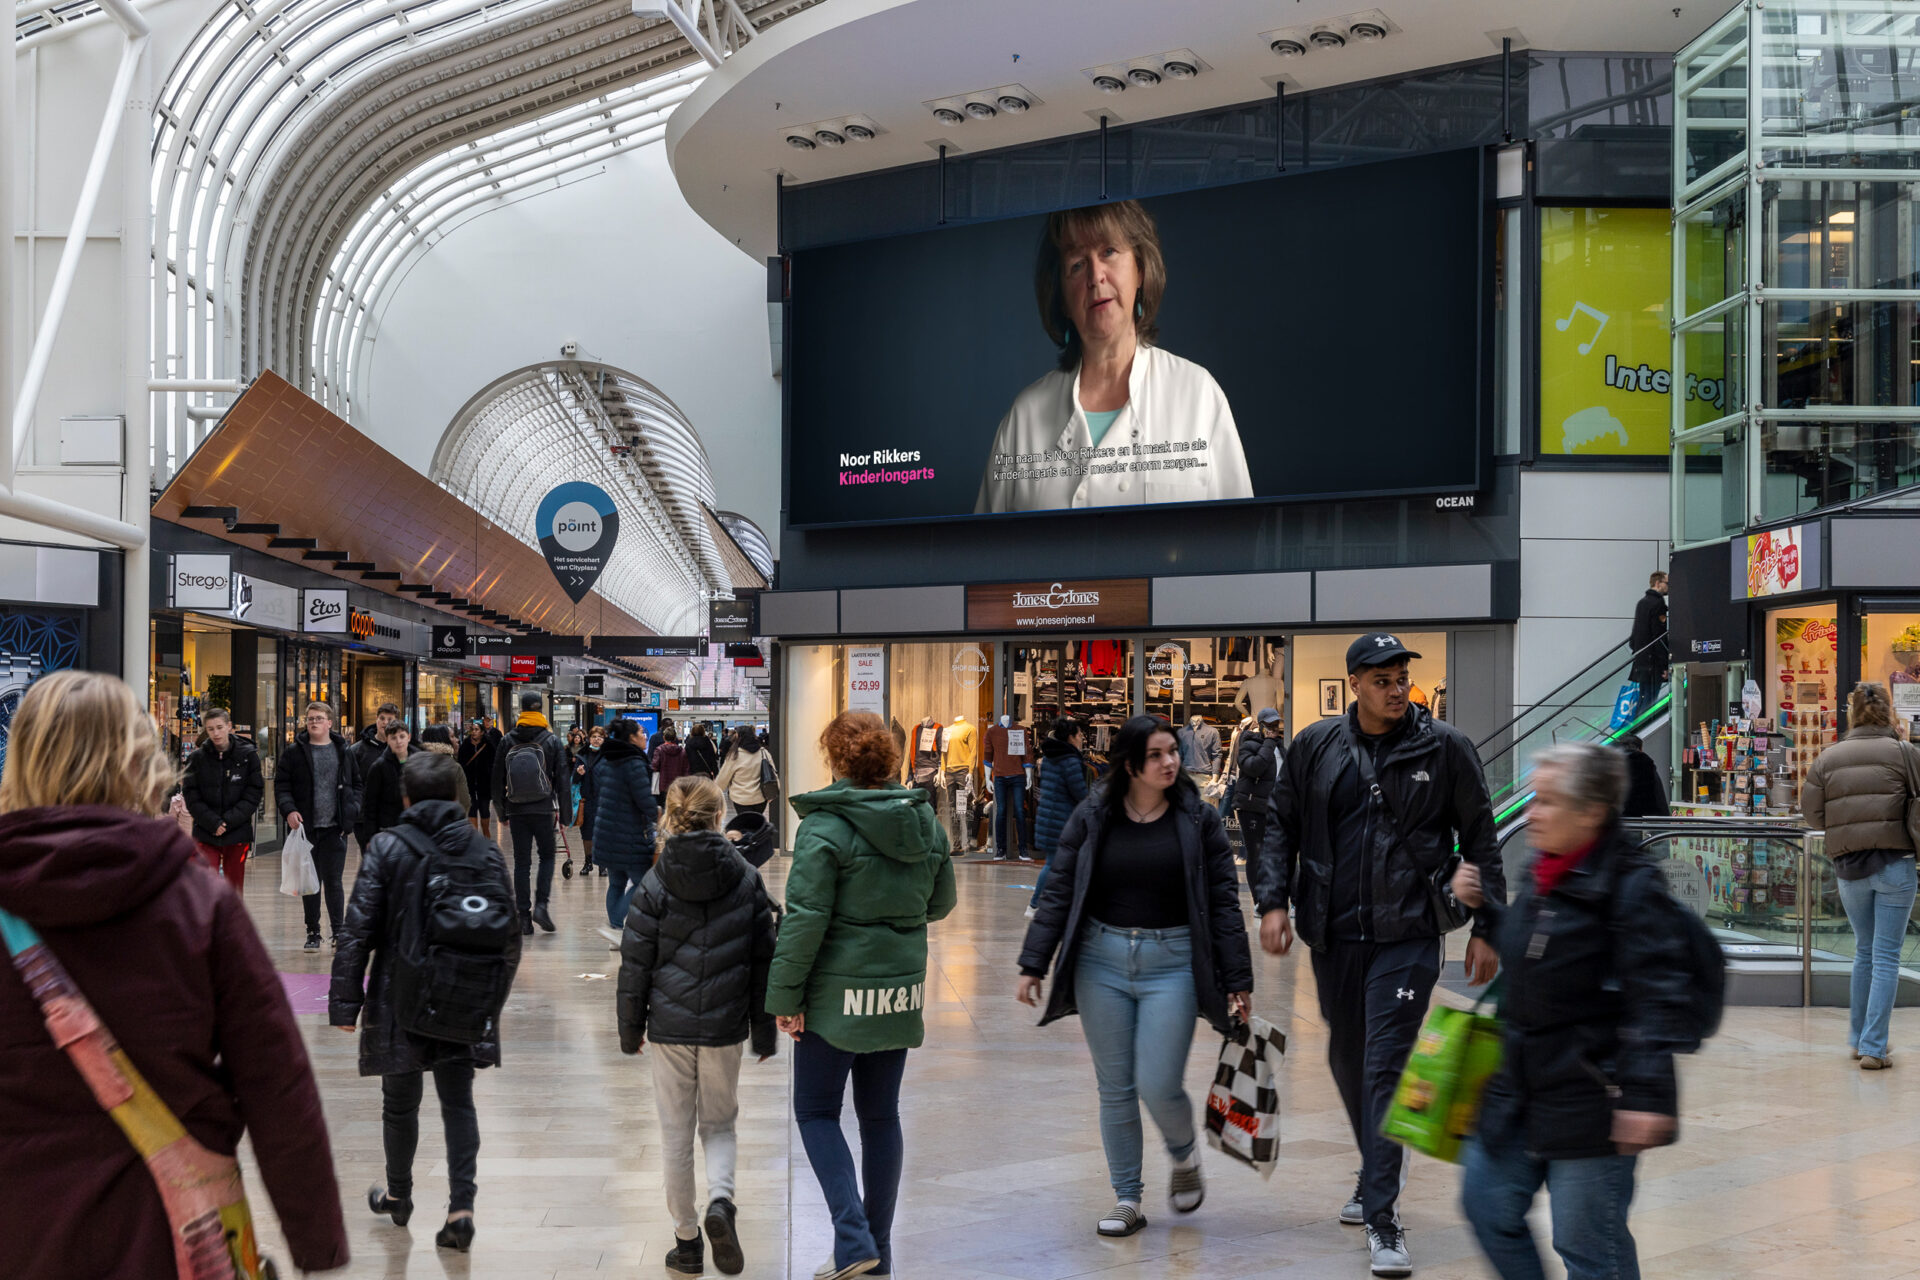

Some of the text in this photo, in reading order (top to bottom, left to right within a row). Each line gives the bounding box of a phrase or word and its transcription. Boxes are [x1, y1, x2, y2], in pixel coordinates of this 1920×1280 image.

[840, 449, 921, 467] Noor Rikkers
[994, 438, 1207, 467] Mijn naam is Noor Rikkers en ik maak me als
[993, 456, 1208, 481] kinderlongarts en als moeder enorm zorgen...
[839, 467, 935, 486] Kinderlongarts
[1436, 496, 1474, 508] OCEAN
[558, 521, 597, 535] point
[569, 564, 598, 572] Cityplaza
[178, 572, 225, 590] Strego
[310, 598, 342, 616] Etos
[1016, 614, 1095, 628] www.jonesenjones.nl
[513, 657, 535, 665] bruna
[858, 659, 873, 667] SALE
[1147, 663, 1192, 671] SHOP ONLINE
[851, 680, 880, 692] € 29,99
